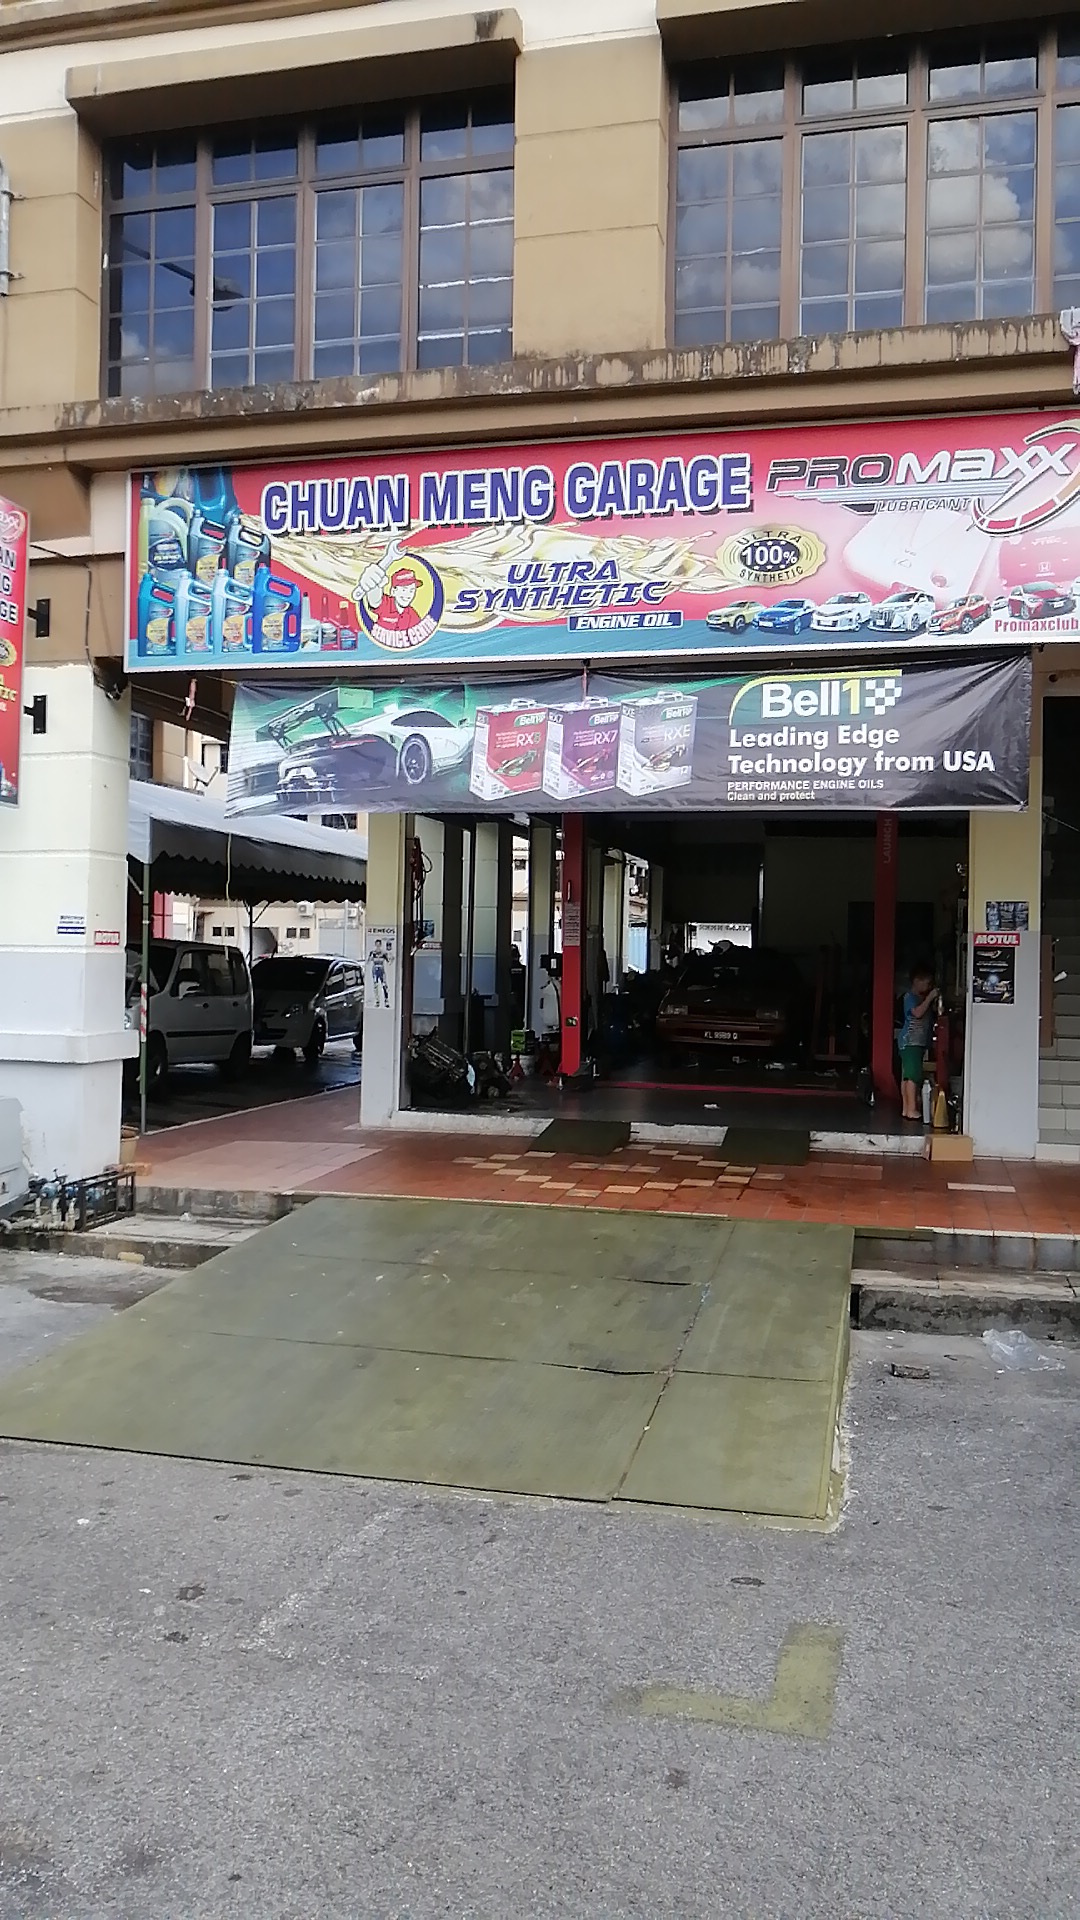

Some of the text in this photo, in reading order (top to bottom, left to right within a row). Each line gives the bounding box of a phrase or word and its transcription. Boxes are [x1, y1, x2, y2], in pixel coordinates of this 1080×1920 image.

[261, 453, 752, 534] CHUAN MENG GARAGE
[878, 497, 971, 513] LUBRICANT
[736, 530, 802, 546] ULTRA
[742, 546, 798, 566] 100%
[506, 559, 621, 585] ULTRA
[739, 565, 804, 583] SYNTHETIC
[453, 581, 669, 611] SYNTHETIC
[575, 611, 674, 630] ENGINE OIL
[994, 617, 1079, 633] Promaxclub
[370, 622, 412, 648] SERVICE
[594, 729, 619, 746] RX7
[664, 723, 692, 742] RXE
[728, 723, 901, 750] Leading Edge
[727, 750, 996, 778] Technology from USA
[727, 779, 884, 791] PERFORMANCE ENGINE OILS
[727, 790, 816, 802] Clean and protect
[974, 934, 1019, 945] MOTUL
